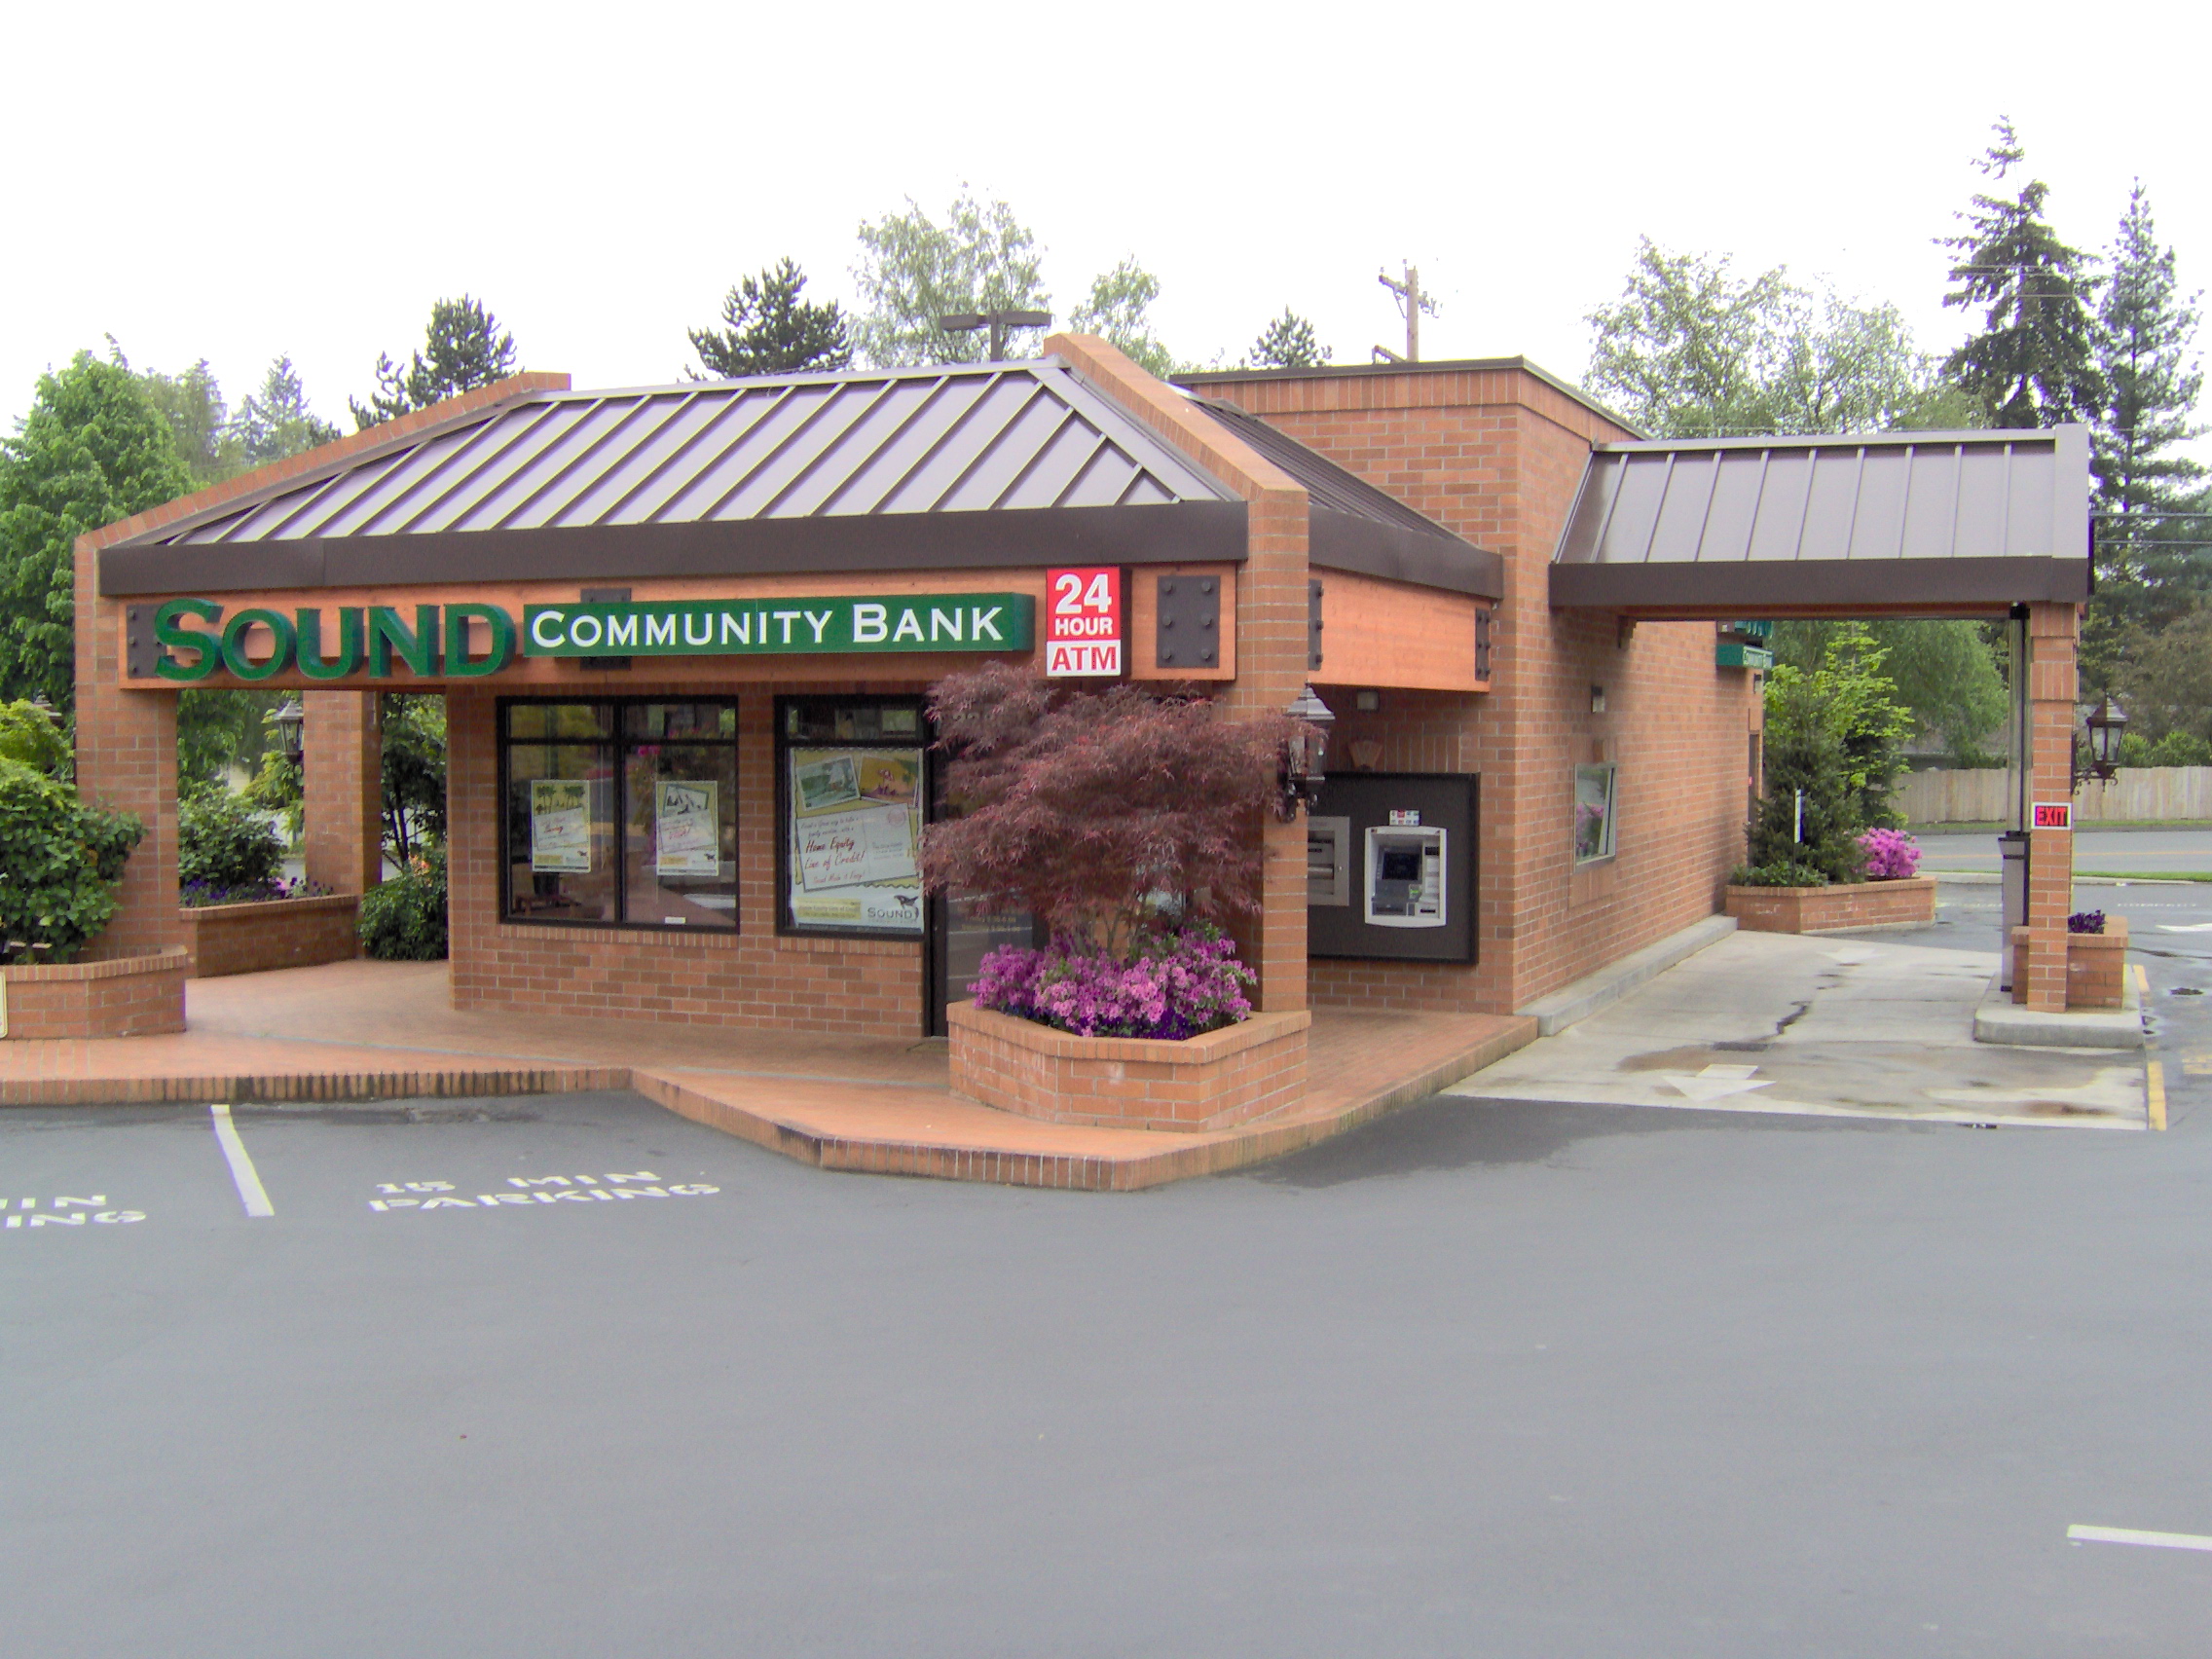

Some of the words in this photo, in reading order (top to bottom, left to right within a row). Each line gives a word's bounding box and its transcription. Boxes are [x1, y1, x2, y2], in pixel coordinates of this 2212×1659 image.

[1055, 573, 1112, 614] 24
[1054, 616, 1113, 637] HOUR
[154, 597, 517, 682] SOUND
[532, 610, 832, 648] COMMUNITY
[852, 604, 1003, 643] BANK
[1051, 645, 1117, 671] ATM
[2036, 806, 2067, 826] EXIT
[867, 907, 912, 919] SOUND
[506, 1170, 662, 1189] MIN
[368, 1184, 720, 1211] PARKING
